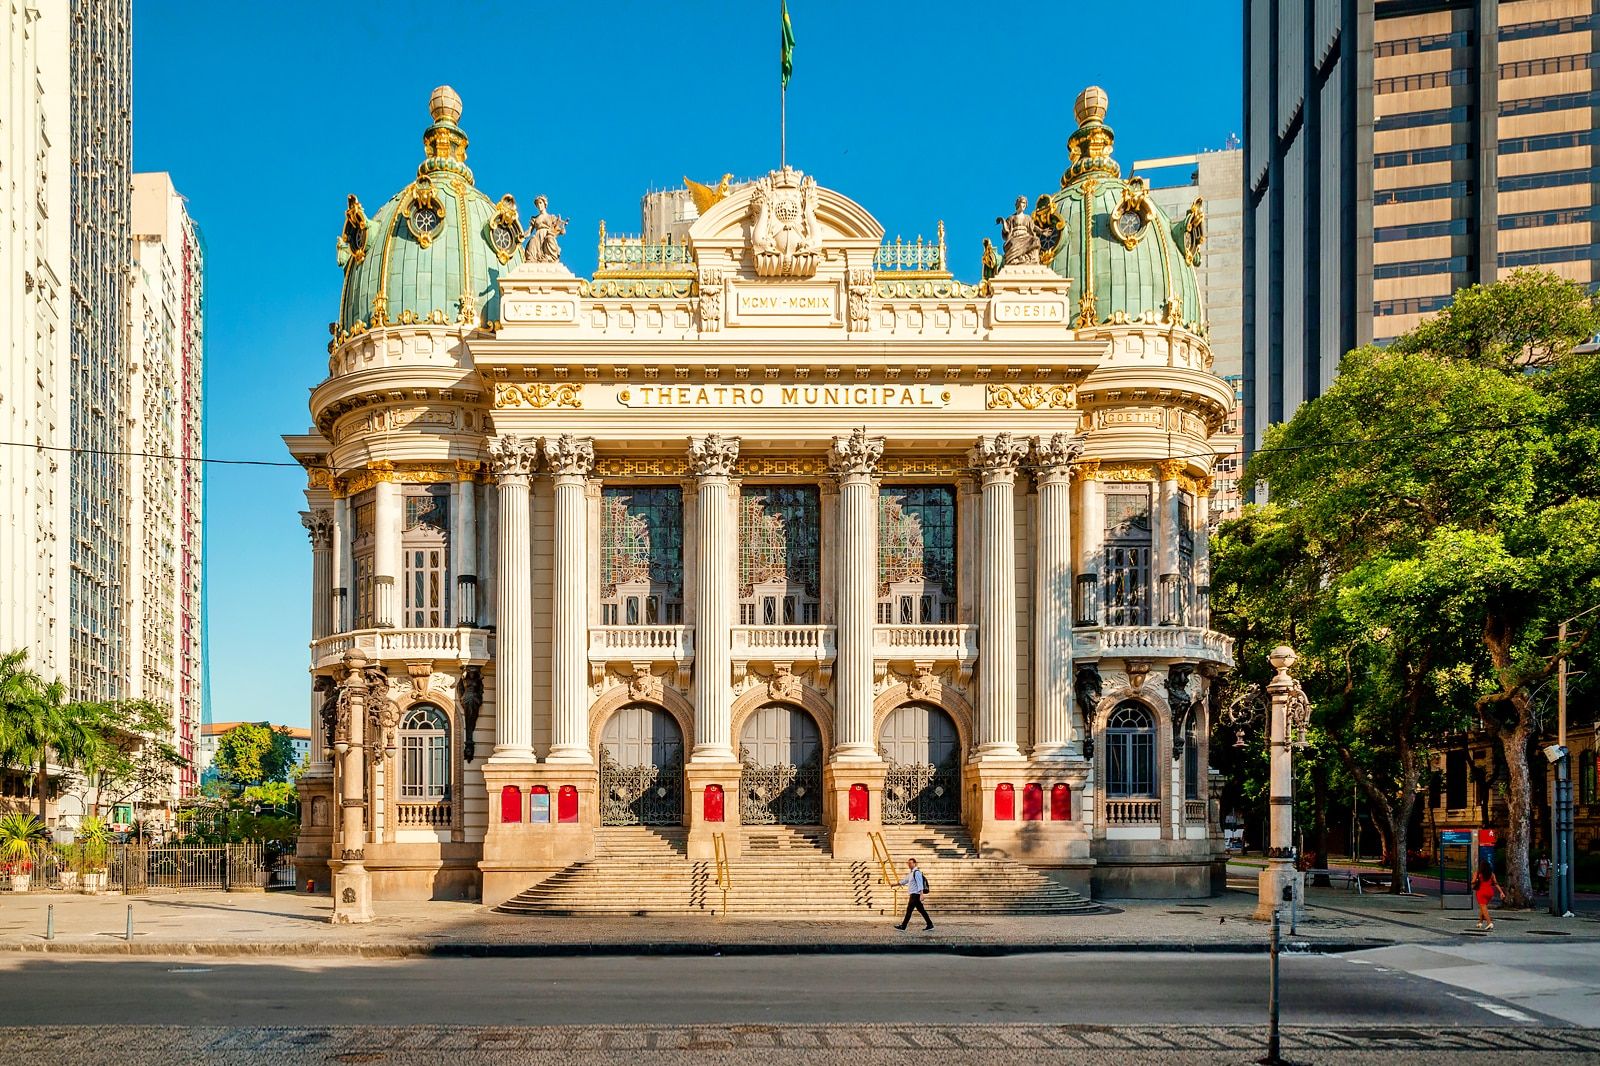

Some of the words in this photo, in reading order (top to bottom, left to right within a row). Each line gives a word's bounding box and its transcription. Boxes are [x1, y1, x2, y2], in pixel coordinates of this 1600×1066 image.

[1004, 305, 1057, 317] POESIA
[640, 387, 764, 405] THEATRO
[781, 387, 933, 405] MUNICIPAL
[1108, 413, 1158, 422] GOETHE
